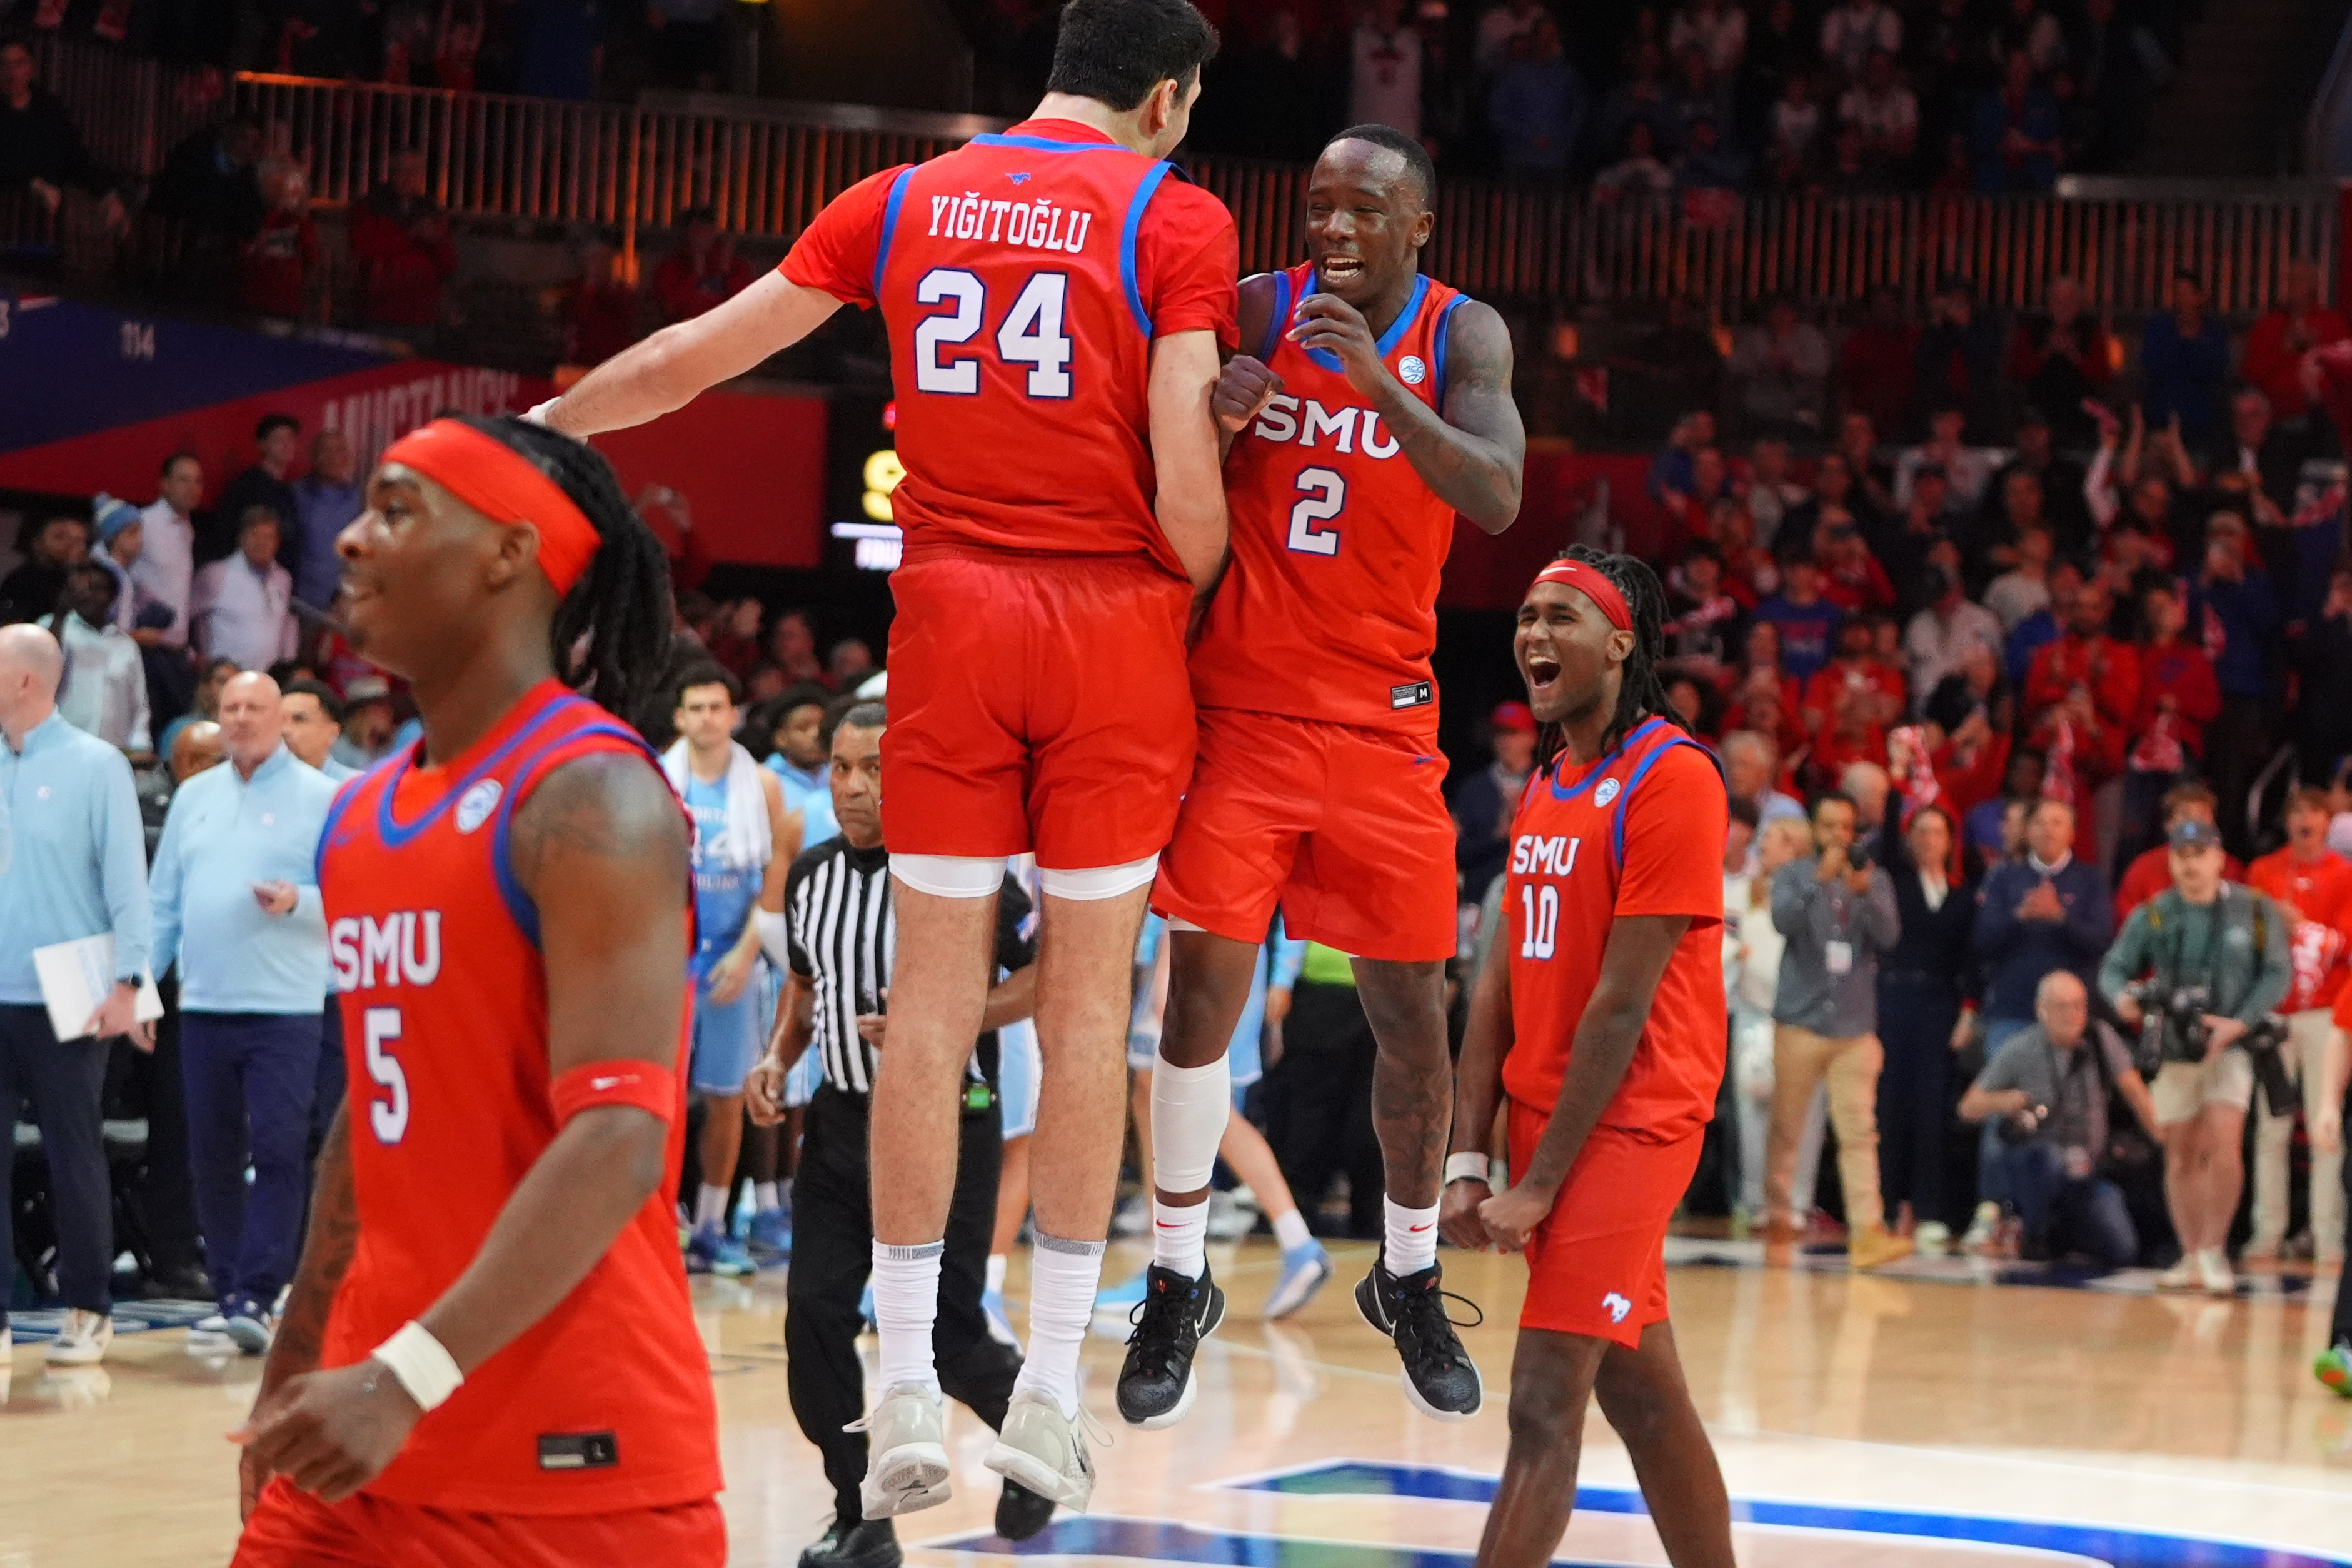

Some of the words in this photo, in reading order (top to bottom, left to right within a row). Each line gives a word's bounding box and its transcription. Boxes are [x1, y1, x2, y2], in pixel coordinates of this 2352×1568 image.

[928, 190, 1092, 254] YIĞITOĞLU
[915, 266, 1073, 399] 24
[1255, 394, 1400, 460] SMU
[1288, 465, 1347, 556] 2
[1419, 688, 1428, 698] M
[1512, 835, 1581, 877] SMU
[331, 909, 441, 993] SMU
[1521, 883, 1560, 960] 10
[363, 1005, 410, 1145] 5
